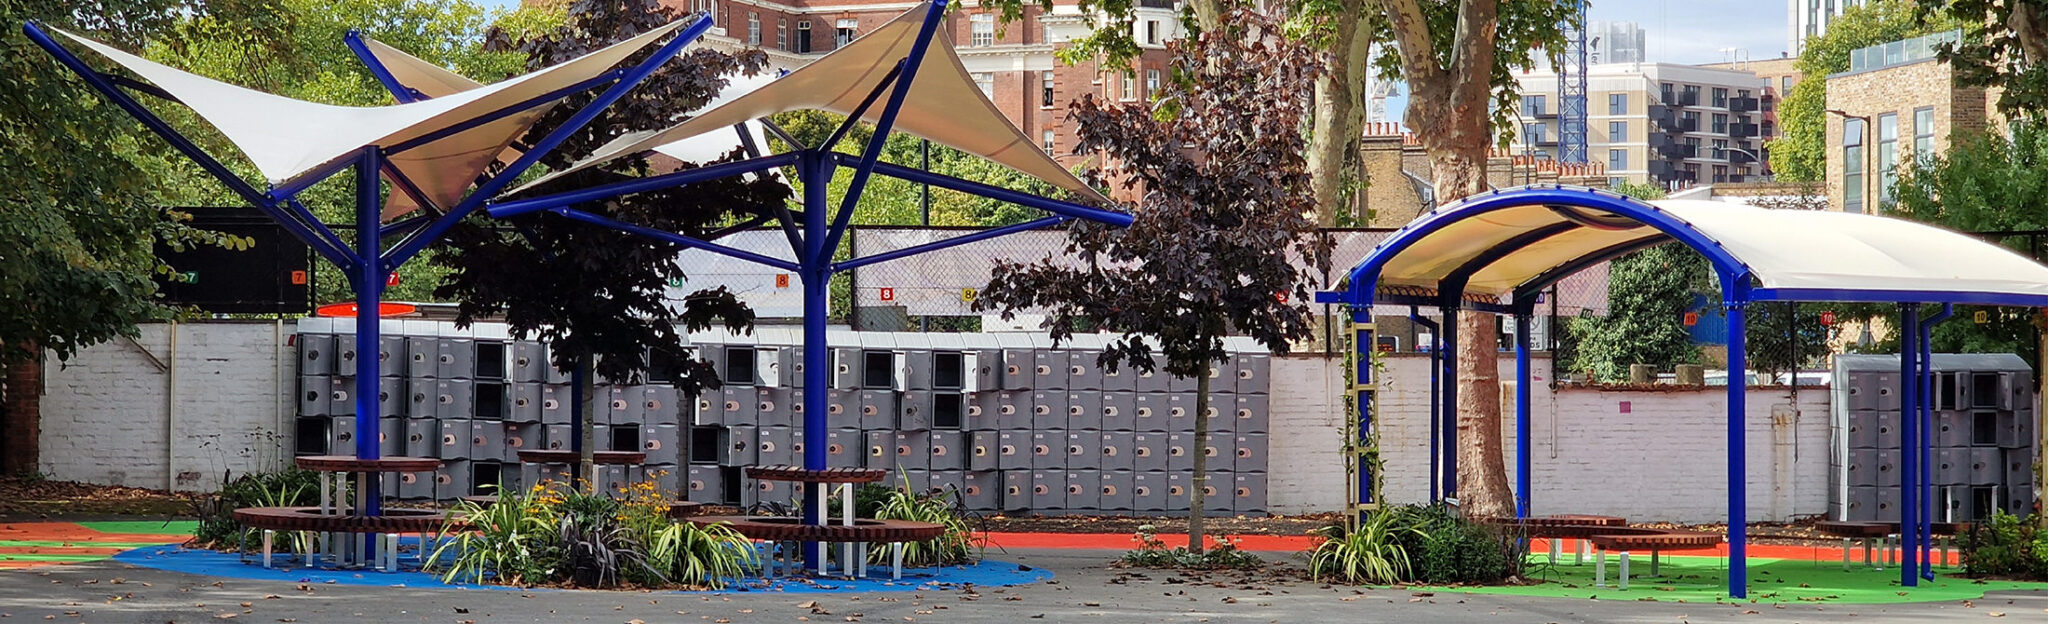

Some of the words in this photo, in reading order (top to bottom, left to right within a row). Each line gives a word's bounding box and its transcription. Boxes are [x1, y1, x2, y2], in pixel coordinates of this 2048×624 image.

[188, 273, 195, 282] 7
[295, 273, 302, 282] 7
[390, 274, 396, 283] 7
[780, 276, 786, 285] 8
[883, 289, 891, 299] 8
[965, 289, 971, 299] 8
[1582, 309, 1592, 319] 10
[1824, 313, 1833, 323] 10
[1976, 313, 1985, 322] 10
[1686, 315, 1696, 324] 10
